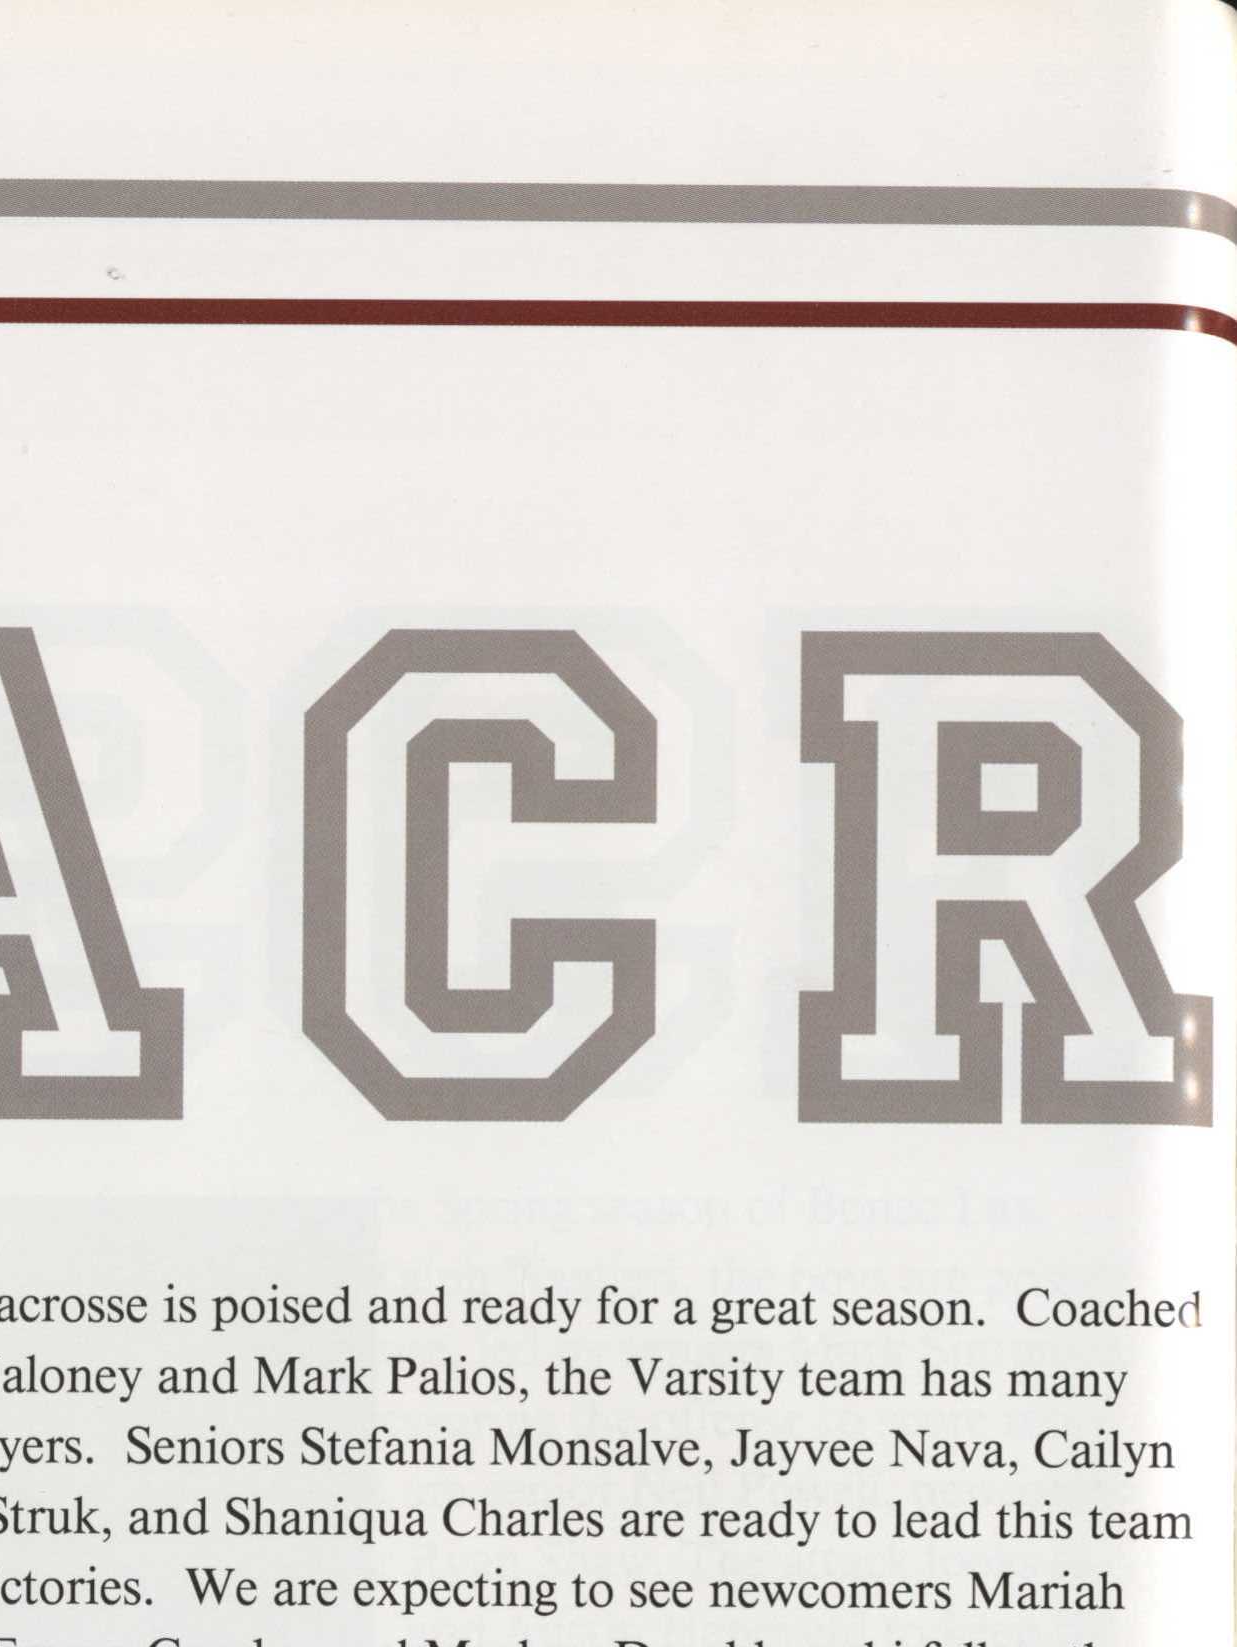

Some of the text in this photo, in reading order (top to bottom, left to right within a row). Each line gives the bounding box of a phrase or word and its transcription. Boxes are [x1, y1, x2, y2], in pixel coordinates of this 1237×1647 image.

[164, 1283, 197, 1324] is
[212, 1283, 352, 1332] poised
[368, 1285, 447, 1325] and
[463, 1285, 582, 1334] ready
[597, 1285, 659, 1325] for
[673, 1297, 697, 1326] a
[710, 1292, 817, 1335] great
[833, 1298, 985, 1327] season.
[1016, 1287, 1203, 1328] Coached
[158, 1355, 238, 1395] and
[254, 1355, 372, 1395] Mark
[387, 1355, 529, 1403] Palios,
[545, 1356, 612, 1396] the
[627, 1356, 784, 1406] Varsity
[798, 1363, 905, 1397] team
[921, 1358, 992, 1398] has
[1007, 1370, 1128, 1407] many
[126, 1425, 285, 1465] Seniors
[301, 1425, 475, 1466] Stefania
[490, 1427, 713, 1474] Monsalve,
[730, 1428, 874, 1477] Jayvee
[890, 1429, 1018, 1476] Nava,
[1034, 1428, 1174, 1478] Cailyn
[128, 1496, 209, 1536] and
[225, 1496, 428, 1545] Shaniqua
[442, 1497, 604, 1538] Charles
[620, 1509, 684, 1538] are
[700, 1499, 820, 1547] ready
[834, 1504, 877, 1539] to
[892, 1499, 981, 1539] lead
[996, 1499, 1073, 1540] this
[1088, 1506, 1194, 1540] team
[185, 1567, 257, 1607] We
[273, 1578, 338, 1607] are
[353, 1567, 558, 1617] expecting
[571, 1574, 614, 1608] to
[630, 1580, 693, 1609] see
[709, 1581, 952, 1610] newcomers
[968, 1570, 1125, 1611] Mariah
